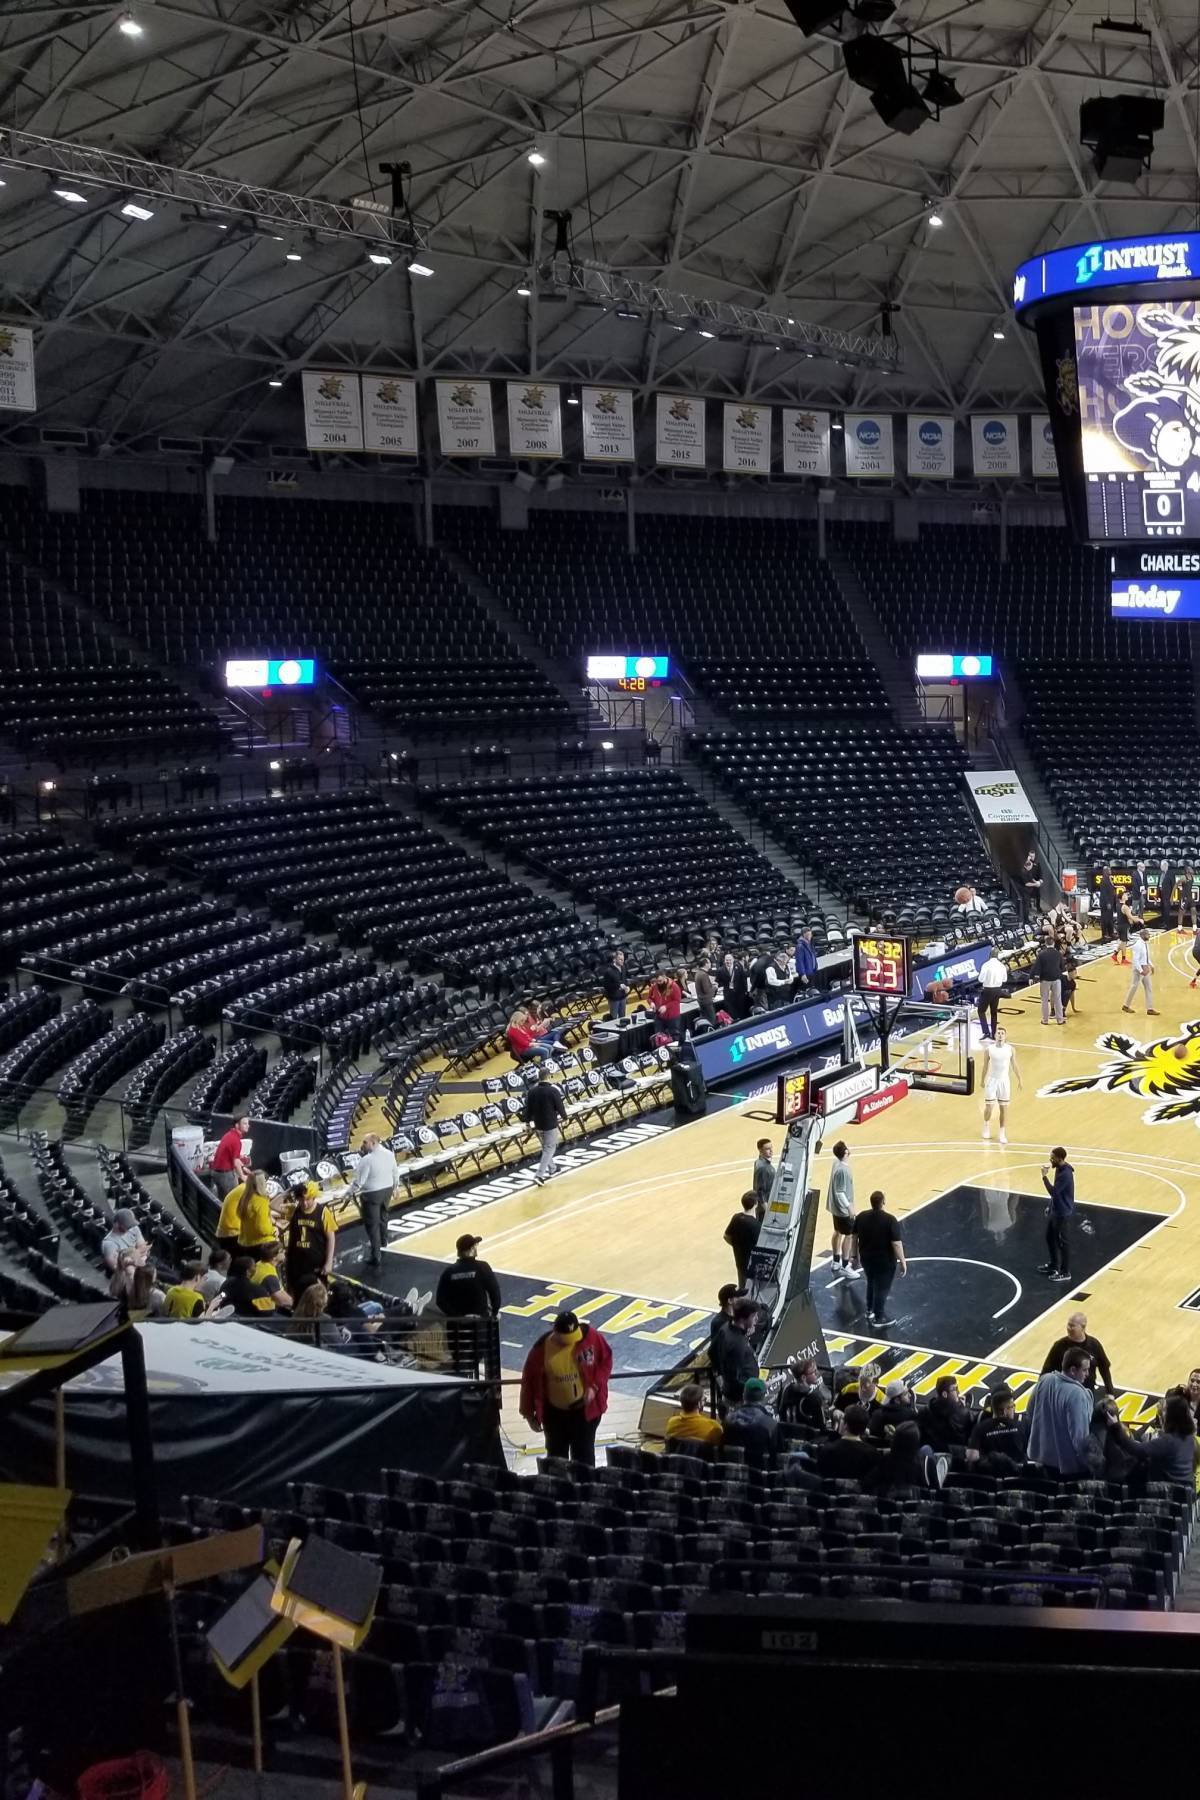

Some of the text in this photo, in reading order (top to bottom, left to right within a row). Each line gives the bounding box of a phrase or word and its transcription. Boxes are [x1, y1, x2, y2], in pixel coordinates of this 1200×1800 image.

[1103, 243, 1189, 270] INTRUST
[323, 433, 347, 444] 2004
[380, 435, 402, 446] 2005
[457, 438, 479, 448] 2007
[526, 440, 547, 449] 2008
[599, 443, 620, 453] 2013
[671, 449, 690, 459] 2015
[738, 458, 756, 468] 2016
[798, 460, 817, 470] 2017
[861, 462, 880, 471] 2004
[922, 462, 942, 471] 2007
[268, 471, 297, 484] 122
[1157, 494, 1171, 516] 0
[1140, 553, 1200, 572] CHARLES
[1126, 585, 1181, 614] Today
[618, 677, 646, 692] 4:28
[859, 940, 902, 959] 46:32
[866, 958, 897, 988] 23
[745, 1025, 787, 1052] INTRUST
[768, 1633, 812, 1650] 102
